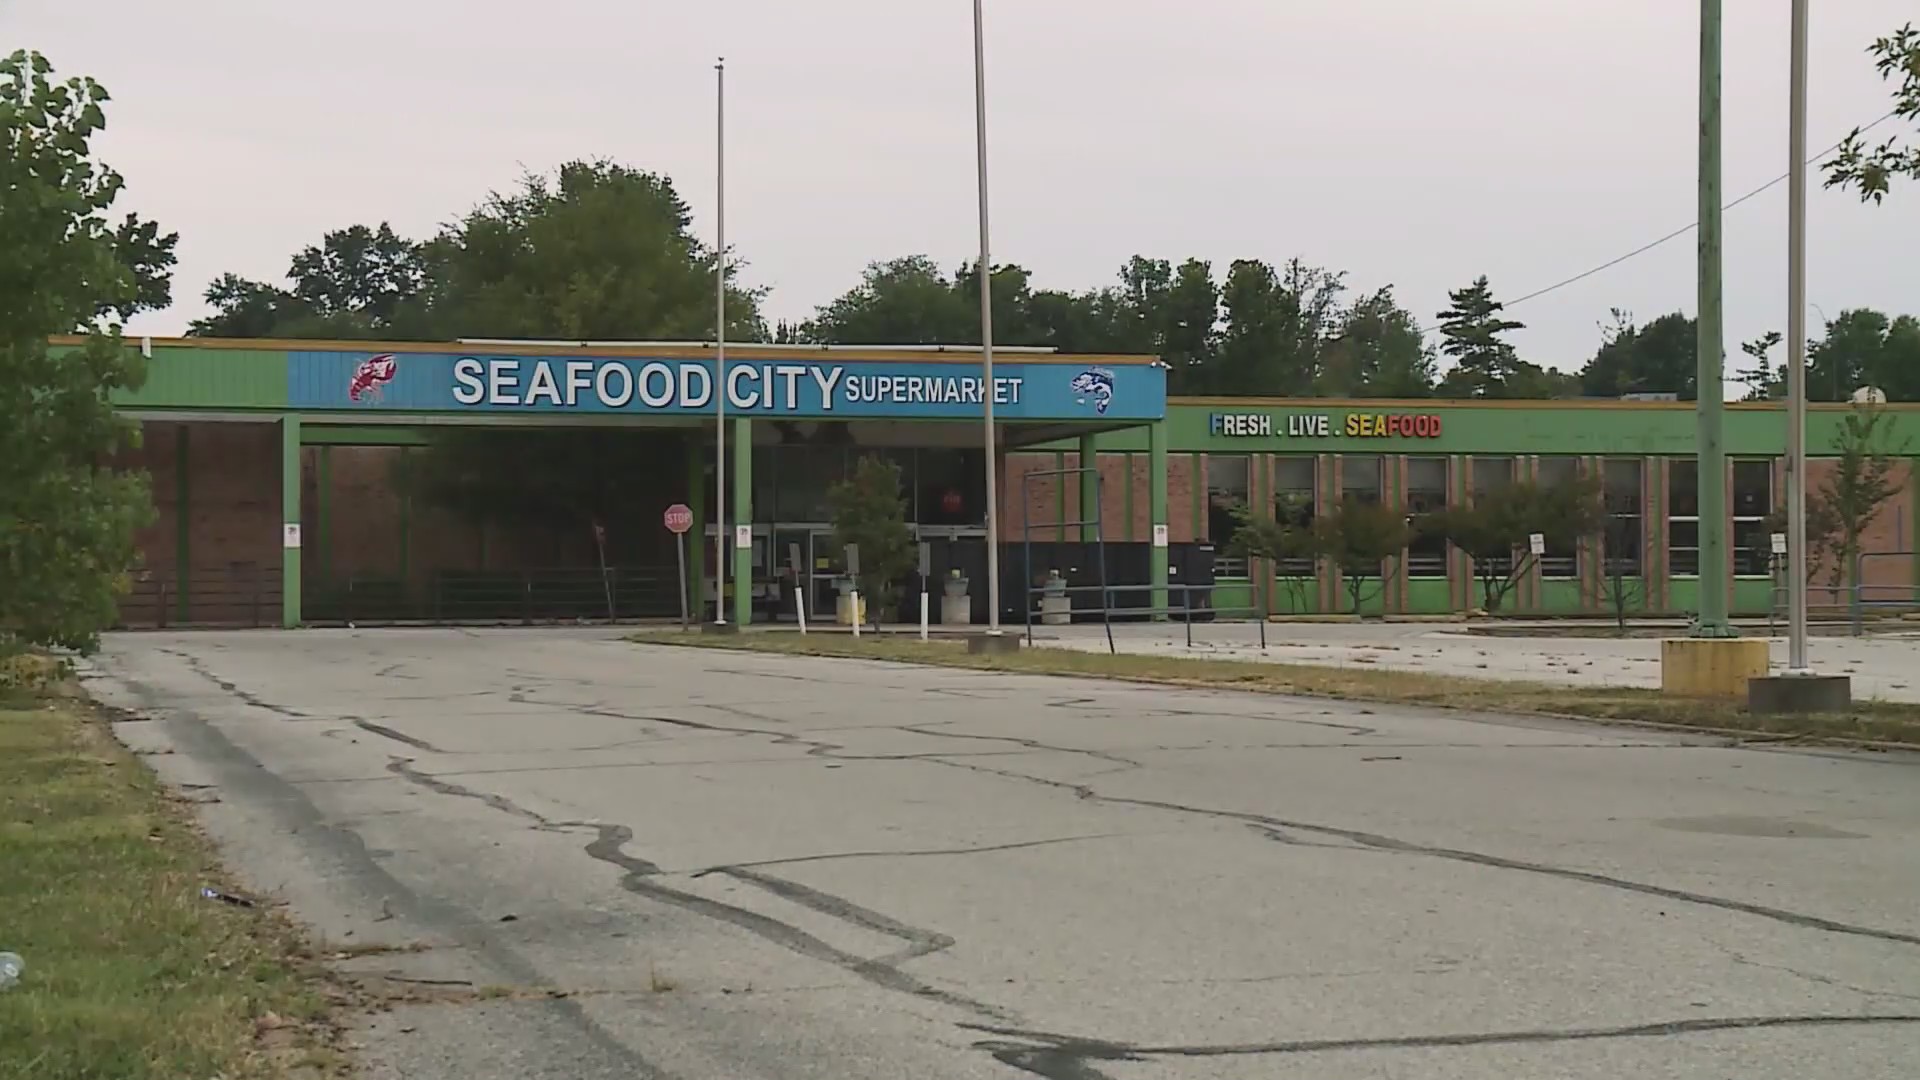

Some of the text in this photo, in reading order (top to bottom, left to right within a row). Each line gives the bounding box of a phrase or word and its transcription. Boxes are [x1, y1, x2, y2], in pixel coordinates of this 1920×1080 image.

[452, 358, 1022, 409] SEAFOOD CITY SUPERMARKET
[1346, 414, 1443, 438] SEAFOOD
[666, 513, 690, 524] STOP
